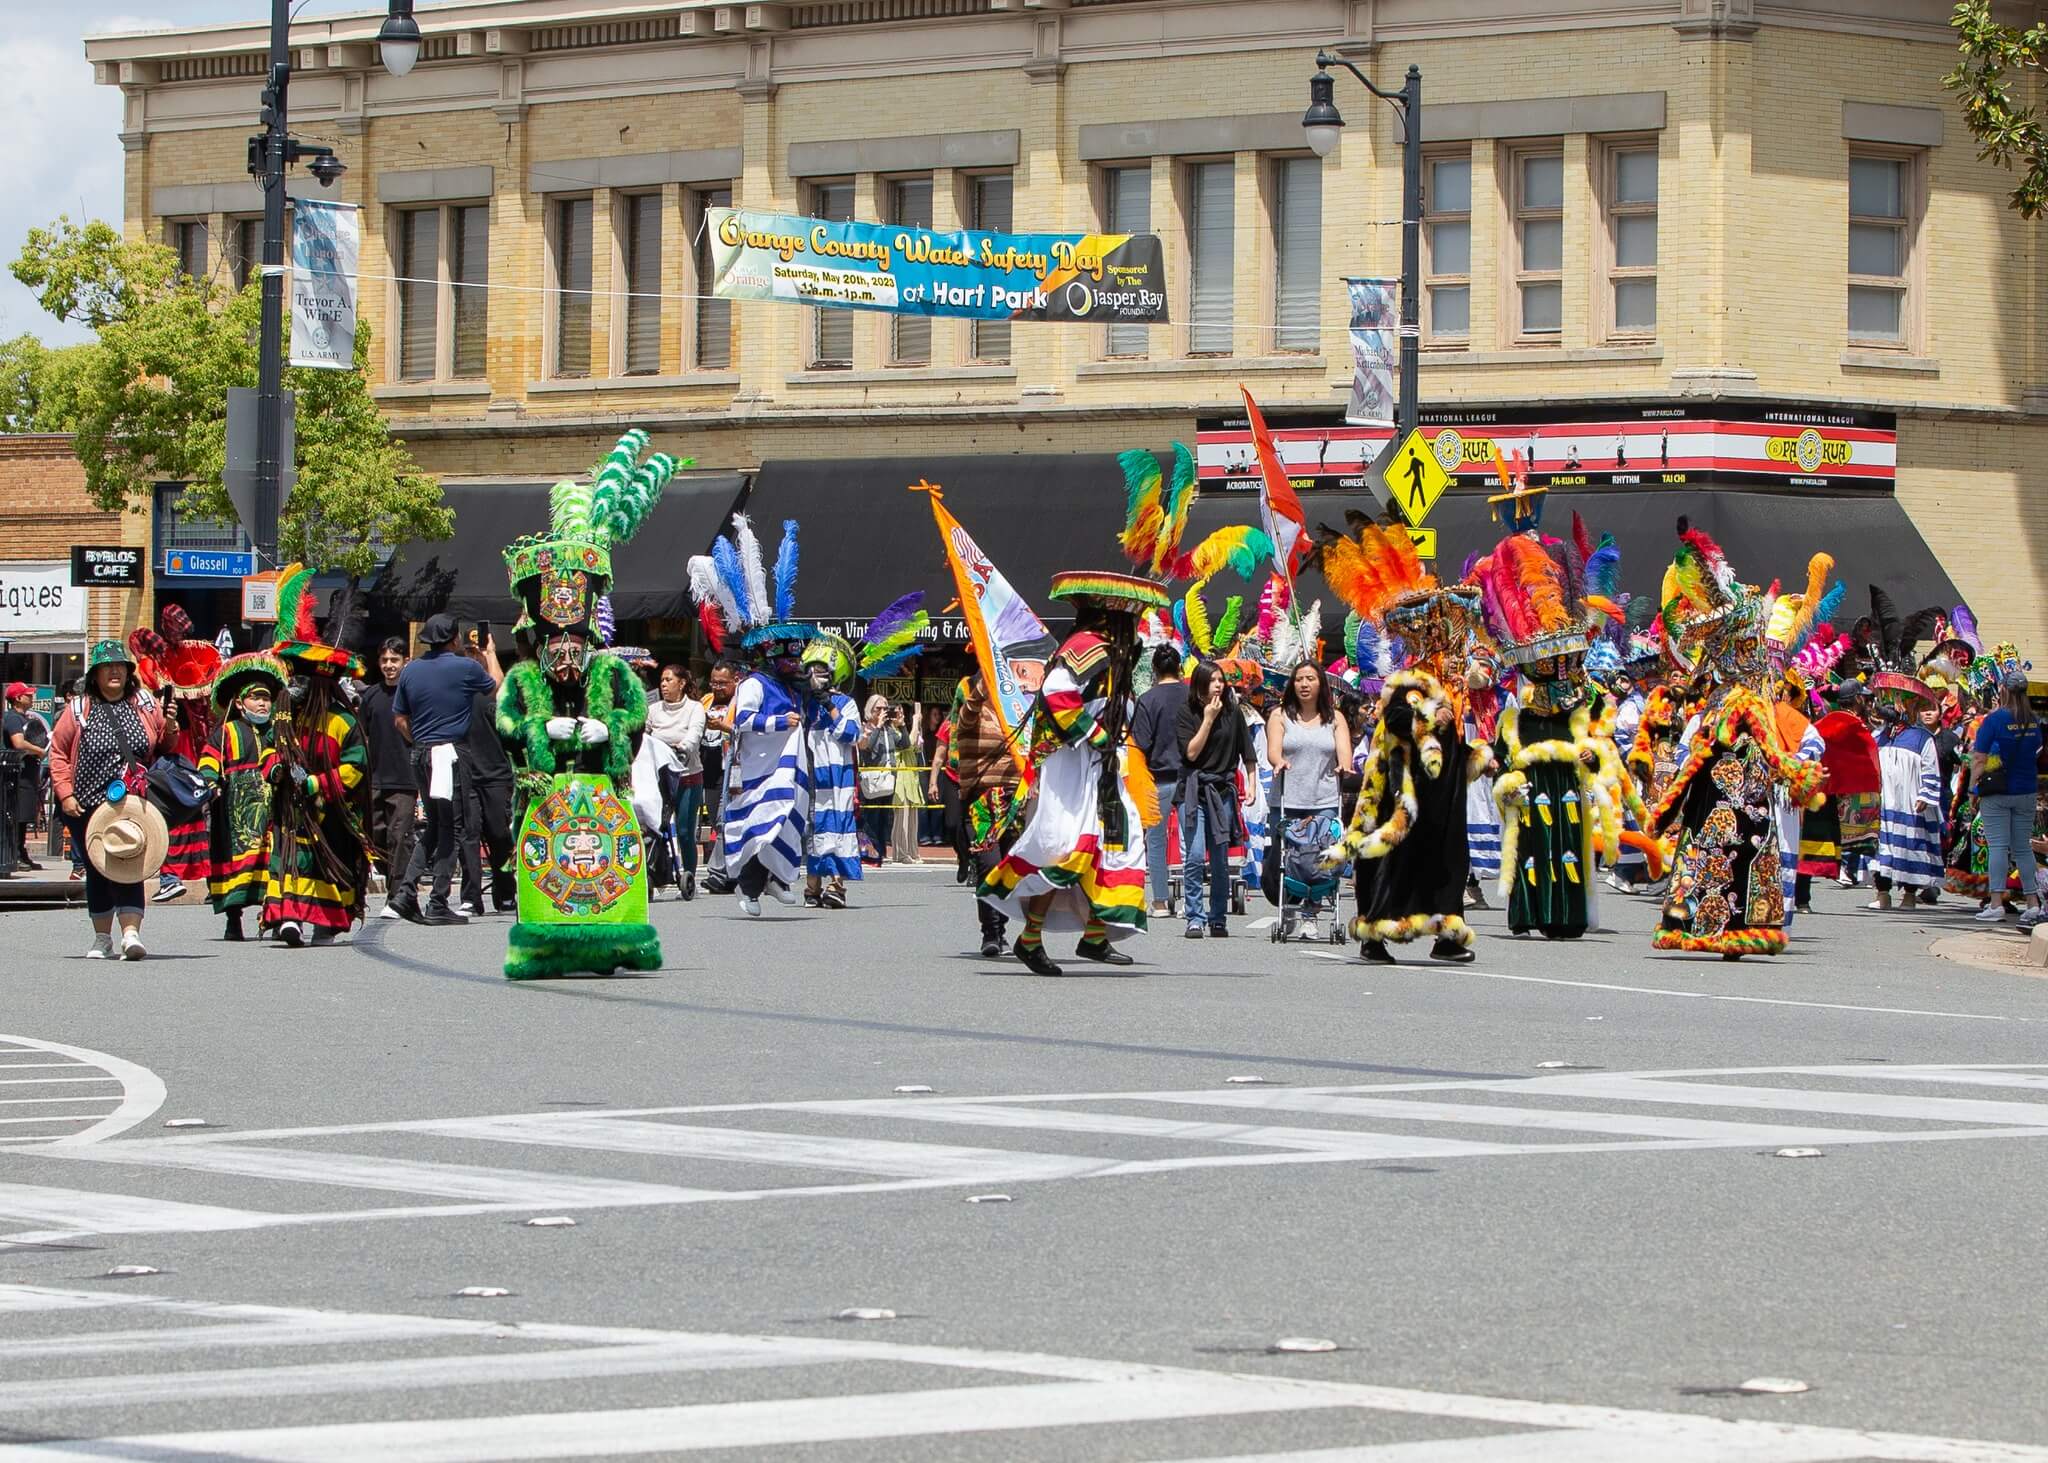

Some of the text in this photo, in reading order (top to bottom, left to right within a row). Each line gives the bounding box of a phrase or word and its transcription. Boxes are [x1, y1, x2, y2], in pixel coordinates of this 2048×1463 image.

[719, 215, 1103, 281] Orange County Water Safety Day
[1106, 264, 1149, 276] Sponsored
[774, 267, 820, 282] Saturday,
[822, 271, 840, 284] May
[843, 274, 870, 287] 20th,
[871, 277, 895, 288] 2023
[1116, 276, 1143, 287] by The
[296, 293, 335, 308] Trevor
[903, 281, 1048, 310] at Hart Park
[1092, 289, 1164, 310] Jasper Ray
[317, 351, 342, 359] ARMY
[1420, 413, 1497, 422] RNATIONAL LEAGUE
[1765, 412, 1854, 425] INTERNATIONAL LEAGUE
[1462, 442, 1489, 463] KUA
[1783, 441, 1798, 463] PA
[1823, 443, 1847, 465] KUA
[1226, 480, 1262, 490] ACROBATICS
[1484, 477, 1513, 487] MARTL
[1612, 475, 1640, 485] RHYTHM
[1662, 474, 1686, 484] TAI CHI
[190, 555, 228, 571] Glassell
[93, 565, 129, 577] CAFE
[845, 621, 869, 639] Vint
[942, 620, 953, 638] &
